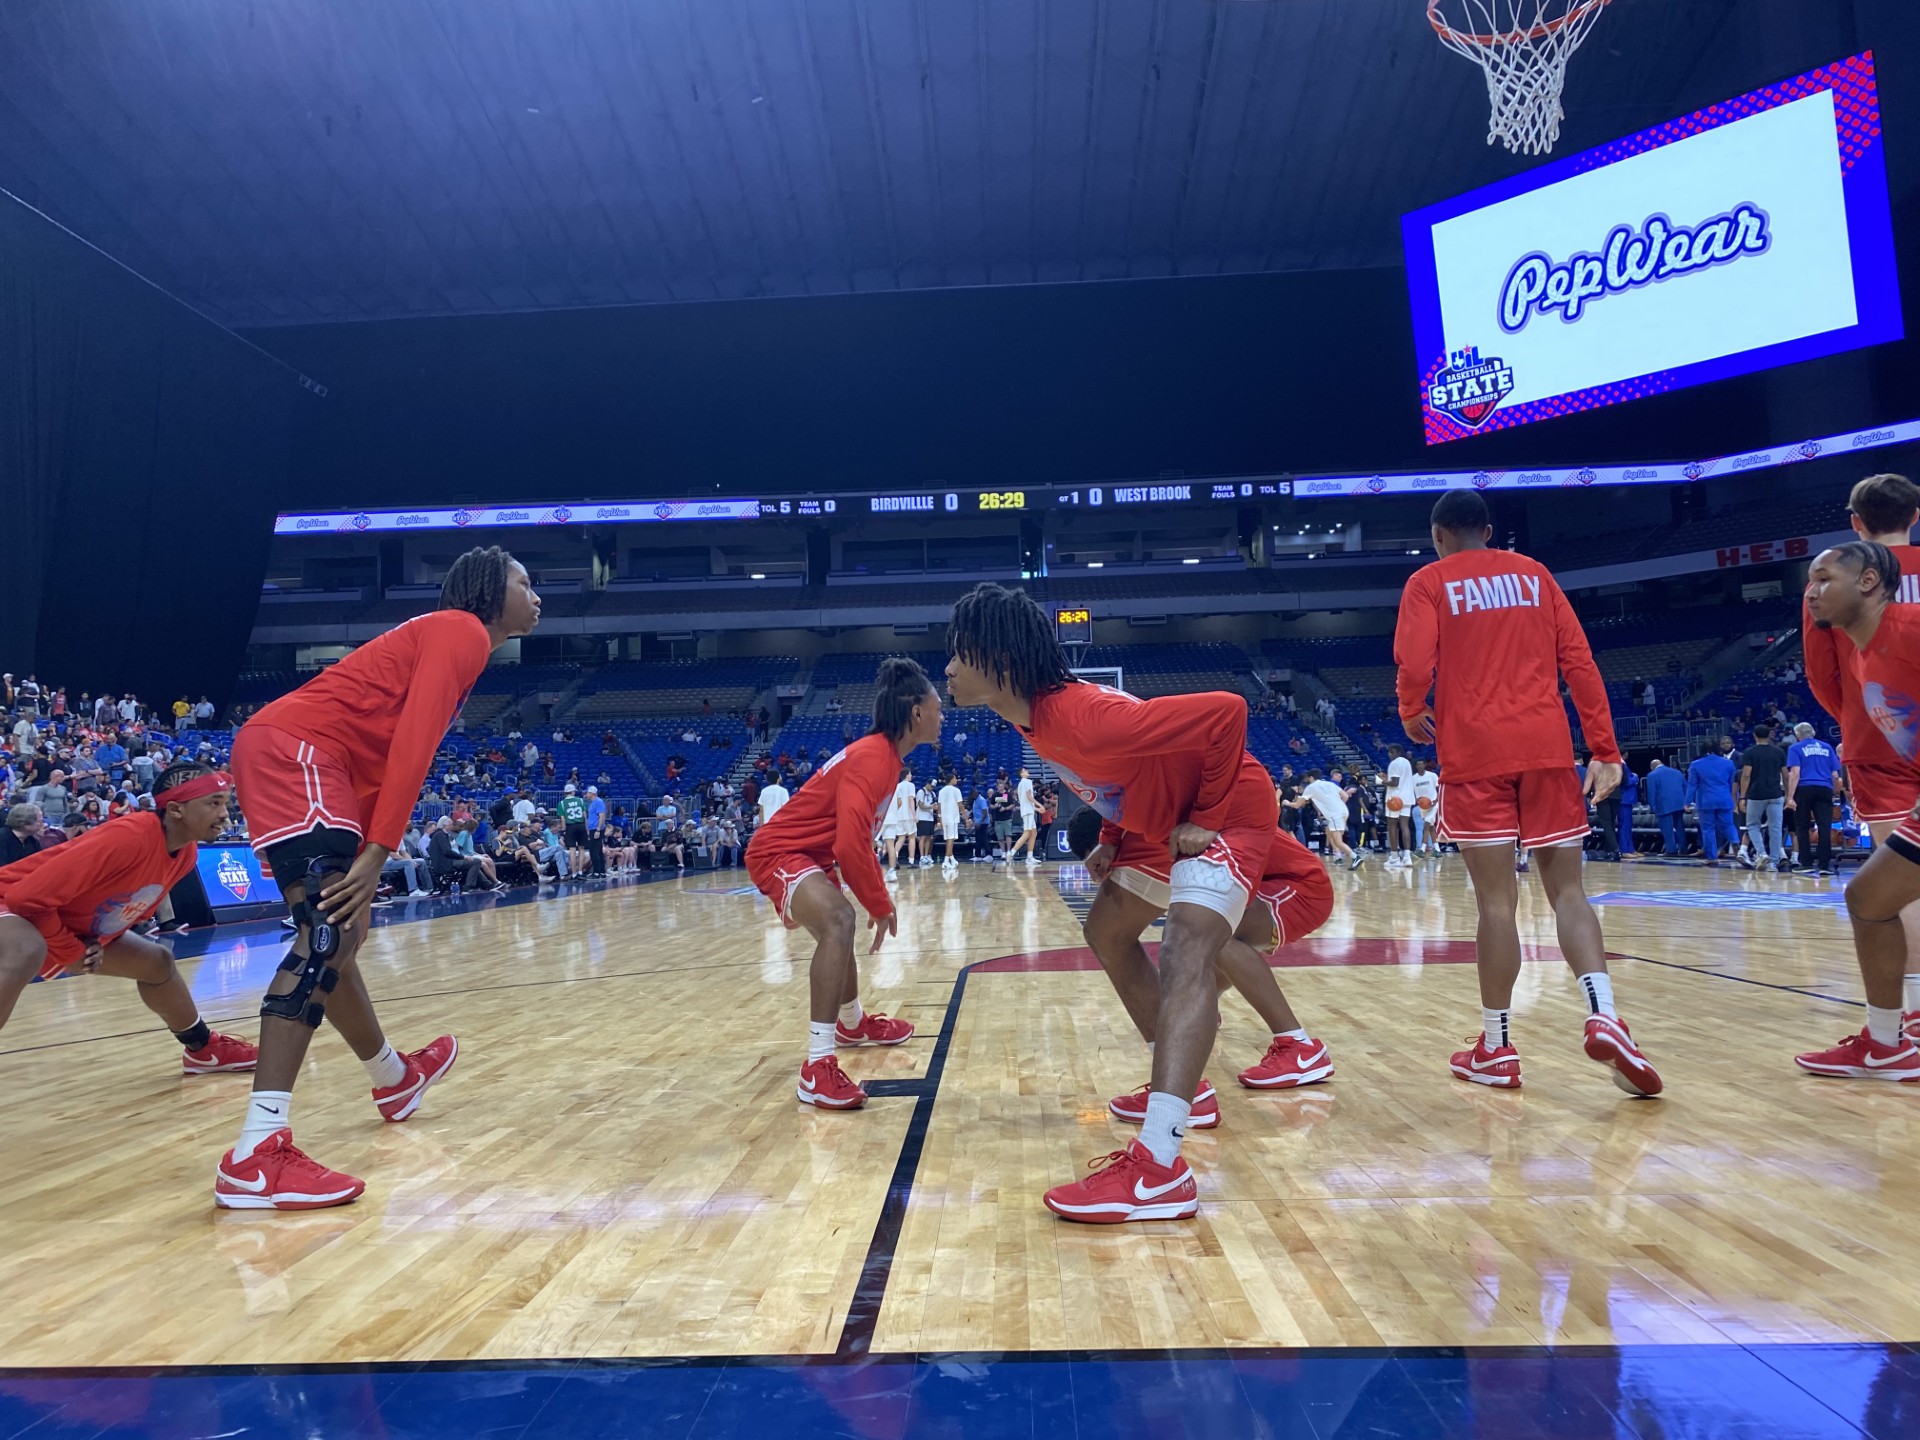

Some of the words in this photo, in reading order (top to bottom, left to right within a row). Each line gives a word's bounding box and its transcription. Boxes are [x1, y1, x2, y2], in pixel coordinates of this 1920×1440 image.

[1499, 204, 1769, 332] PepWear
[1451, 346, 1484, 371] UIL
[1446, 365, 1494, 384] BASKETBALL
[1432, 369, 1513, 406] STATE
[1447, 392, 1499, 411] CHAMPIONSHIPS
[1852, 430, 1895, 447] PepWear
[1732, 454, 1771, 469] PepWear
[1517, 473, 1552, 484] PepWear
[1622, 470, 1657, 480] PepWear
[1260, 485, 1277, 493] TOL
[1280, 482, 1291, 494] 5
[1307, 482, 1342, 493] PepWear
[1412, 477, 1447, 488] PepWear
[1089, 487, 1103, 505] 0
[1114, 487, 1148, 502] WEST
[1149, 485, 1191, 501] BROOK
[1211, 491, 1235, 499] FOULS
[1241, 484, 1253, 496] 0
[945, 493, 958, 510] 0
[979, 492, 1025, 509] 26:29
[1070, 491, 1079, 504] 1
[698, 505, 731, 515] PepWear
[761, 504, 777, 512] TOL
[780, 501, 791, 513] 5
[824, 500, 836, 512] 0
[496, 511, 529, 522] PepWear
[597, 508, 630, 518] PepWear
[297, 519, 329, 529] PepWear
[396, 515, 429, 526] PepWear
[1445, 573, 1540, 616] FAMILY
[1059, 611, 1088, 623] 26:29
[566, 806, 583, 819] 33
[220, 870, 250, 884] STATE
